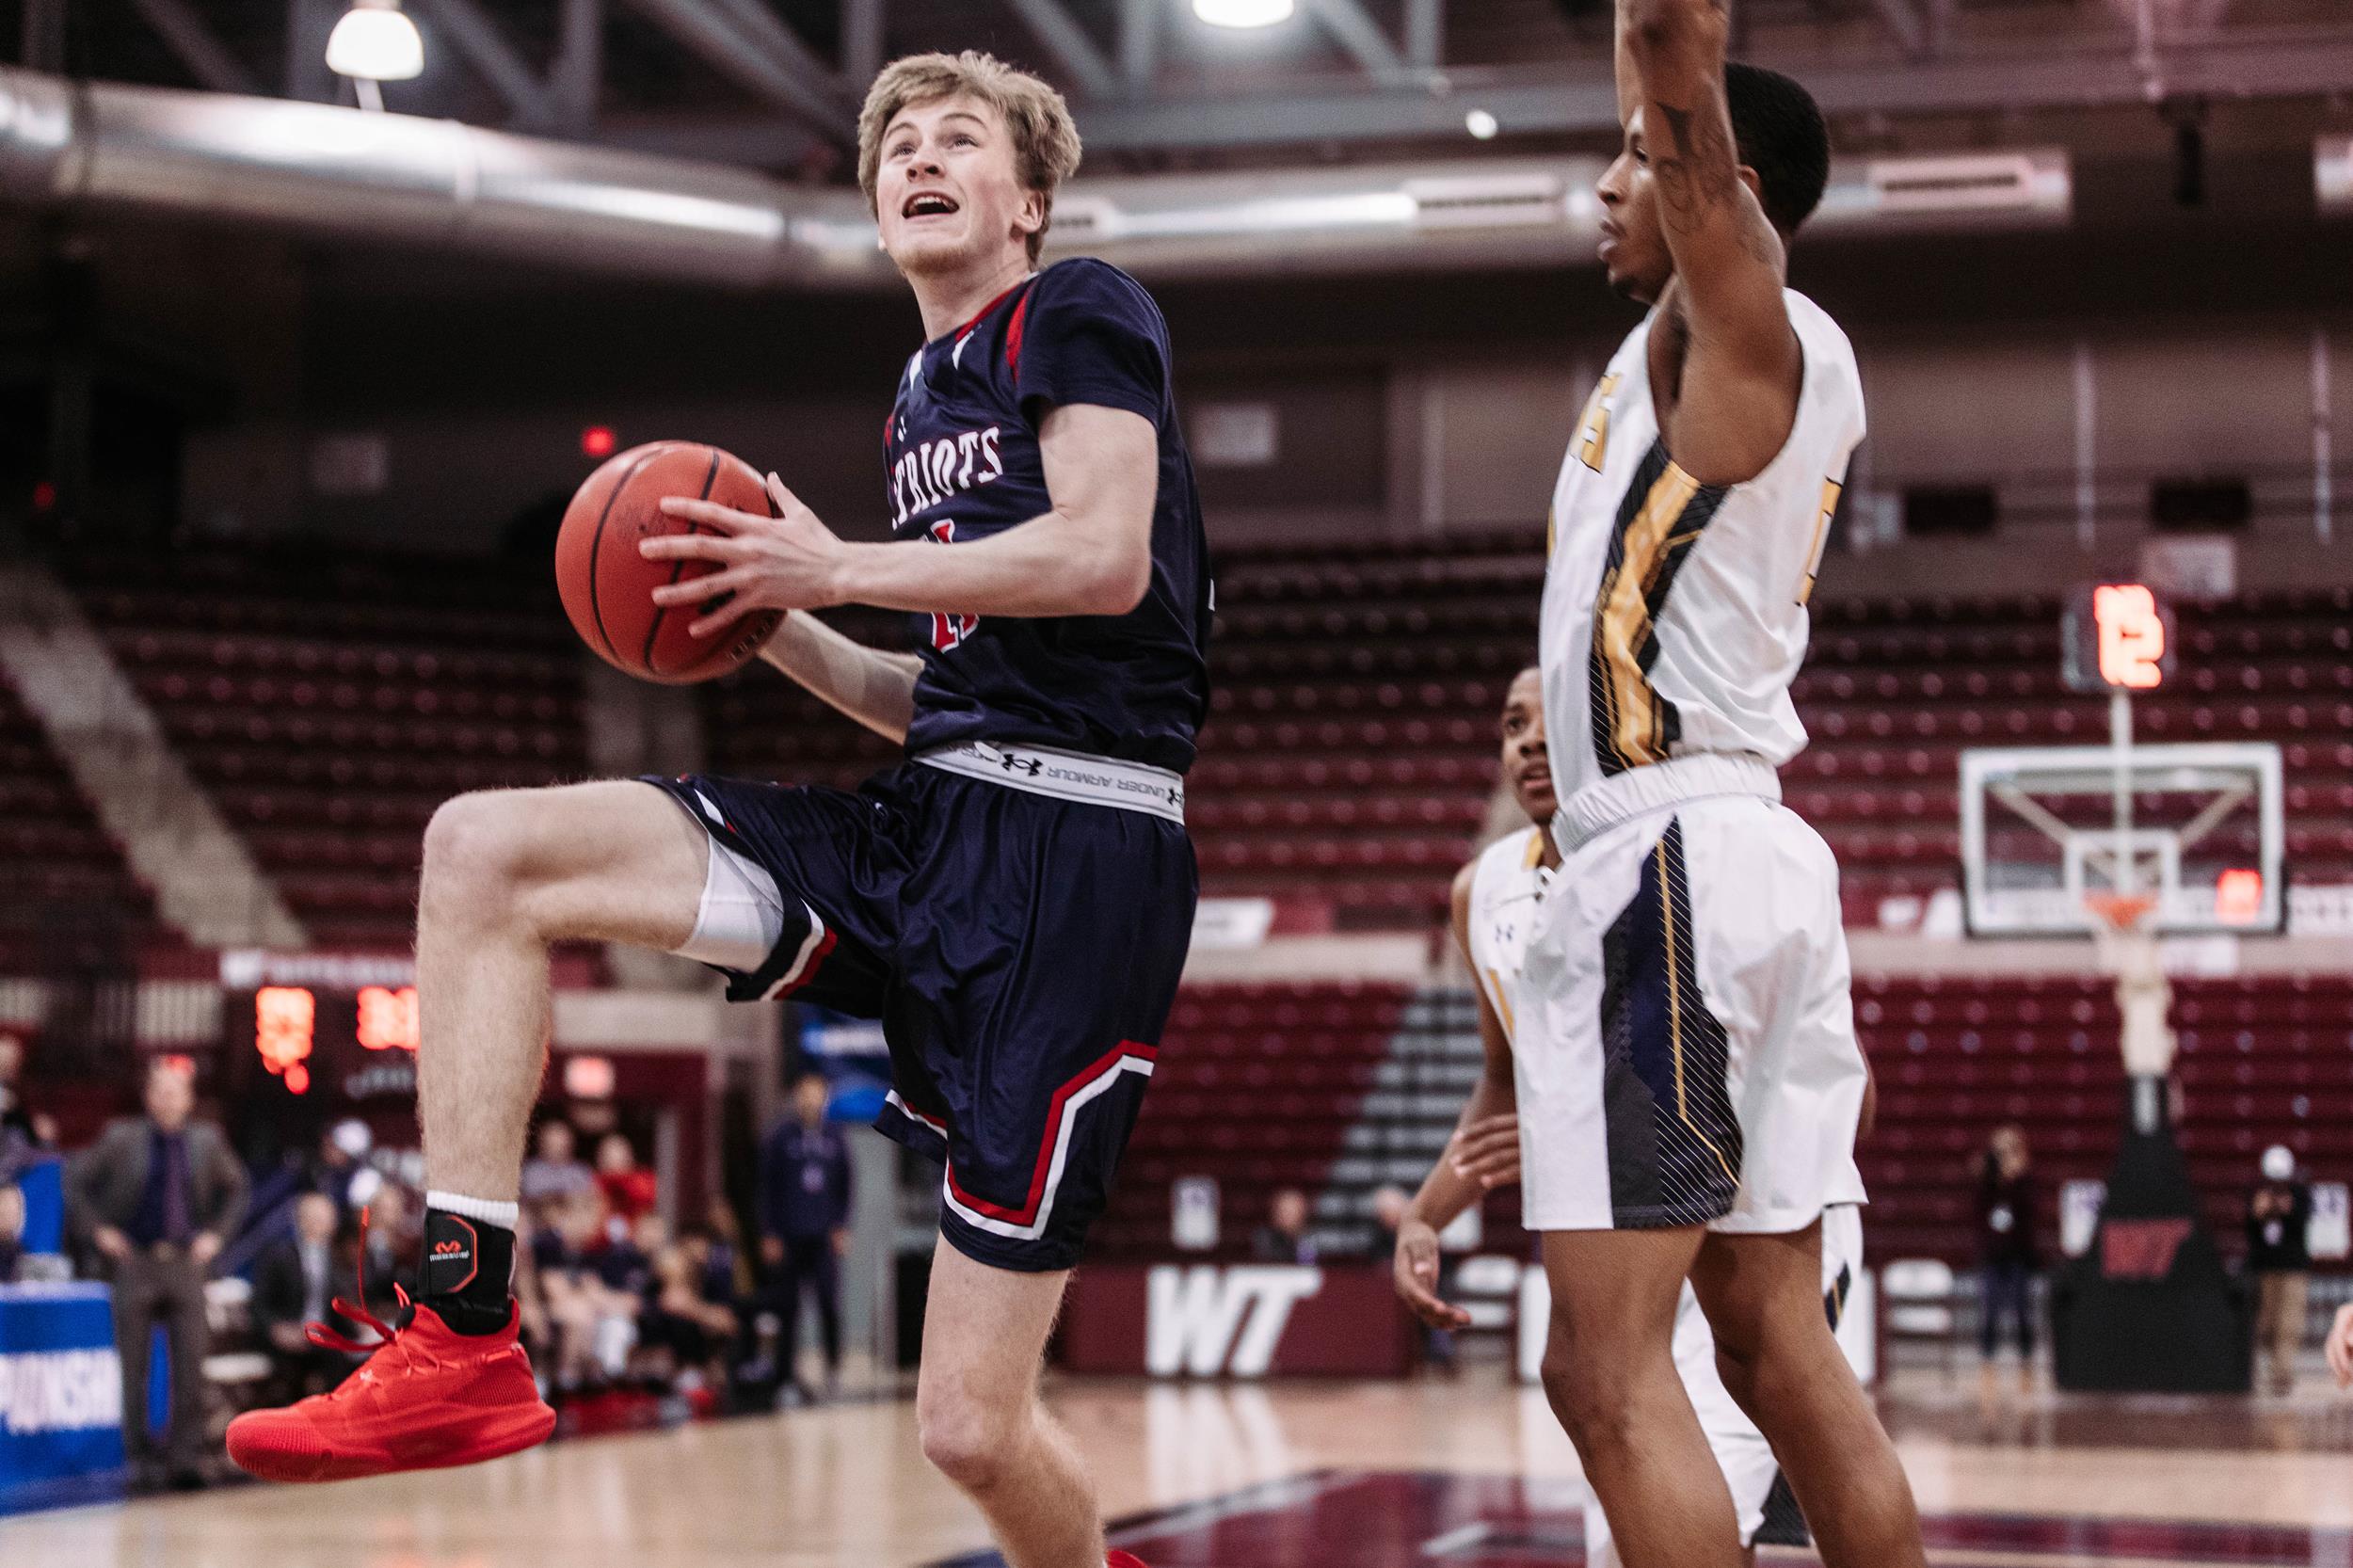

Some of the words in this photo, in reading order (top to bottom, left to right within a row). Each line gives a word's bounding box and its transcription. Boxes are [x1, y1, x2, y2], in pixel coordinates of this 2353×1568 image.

[892, 426, 1003, 531] TRIOTS
[1047, 766, 1112, 788] ARMOUR
[1117, 778, 1166, 799] UNDER
[1144, 1263, 1323, 1378] WT
